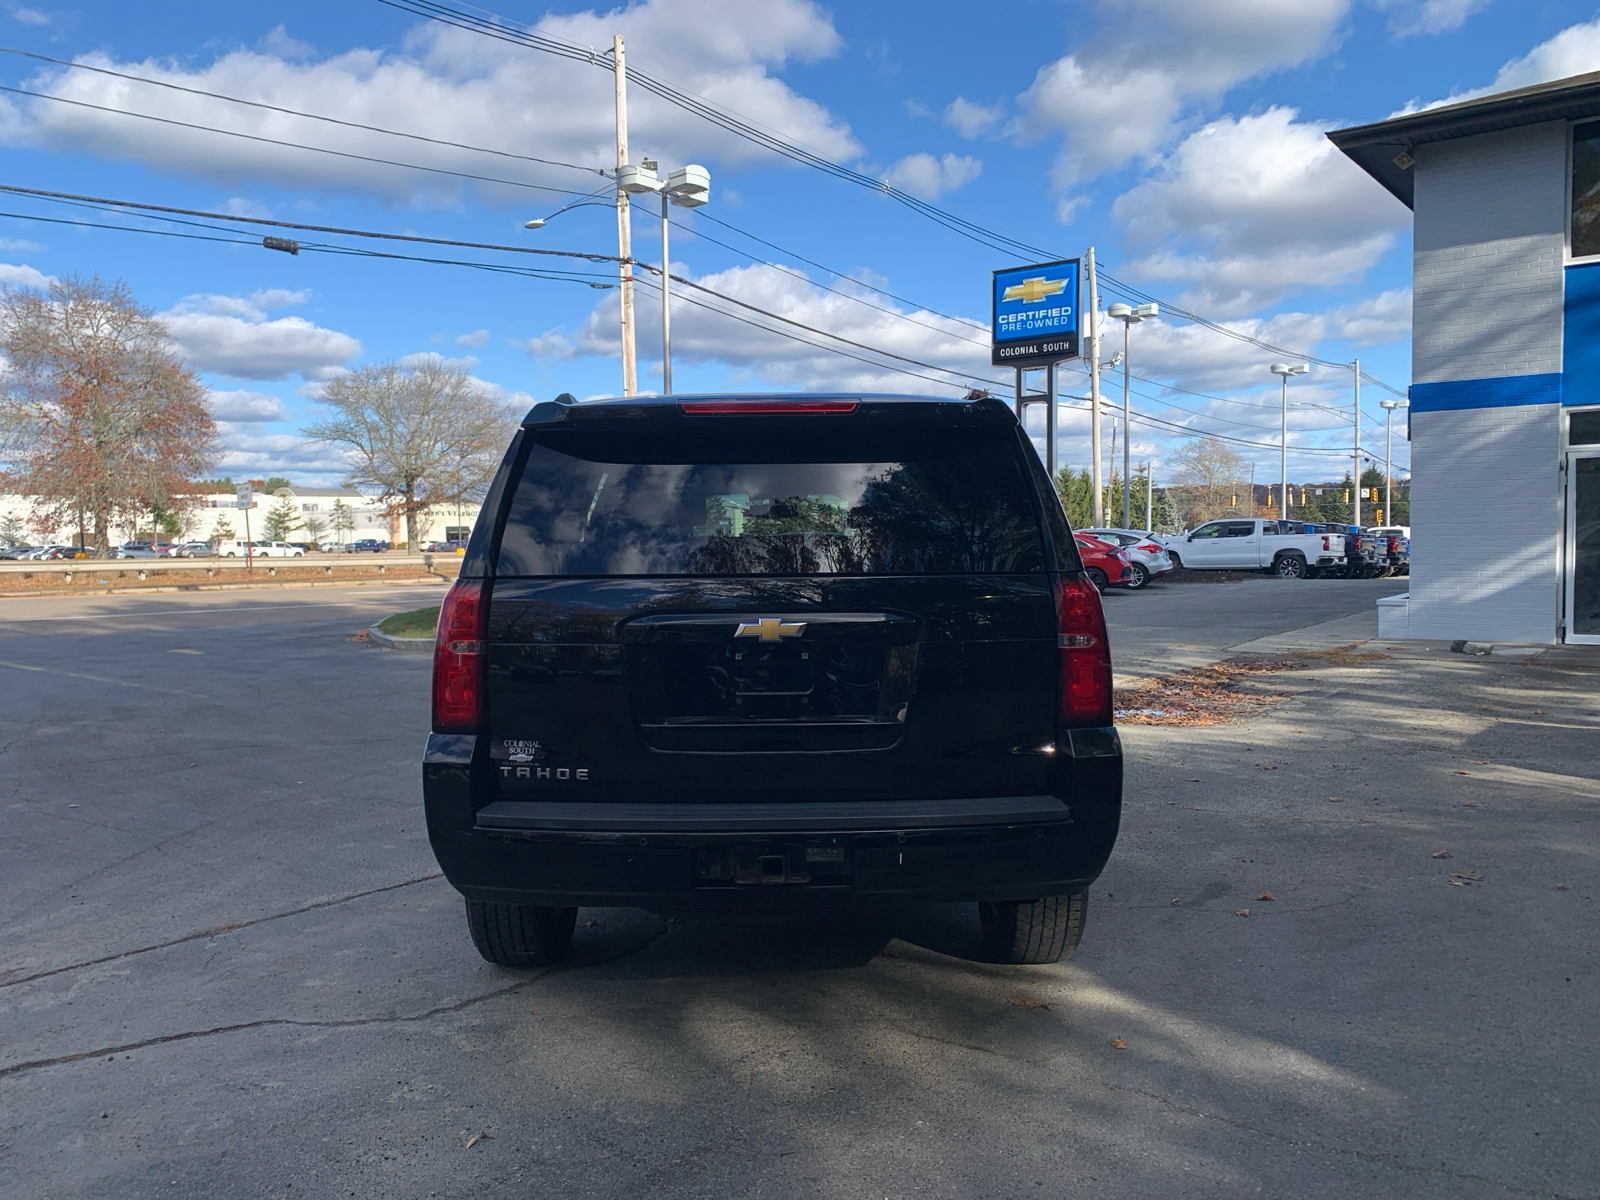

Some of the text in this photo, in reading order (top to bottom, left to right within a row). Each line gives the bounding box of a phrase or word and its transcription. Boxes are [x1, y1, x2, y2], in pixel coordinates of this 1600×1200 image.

[998, 306, 1072, 324] CERTIFIED
[1001, 316, 1068, 332] PRE-OWNED
[1000, 341, 1069, 357] COLONIAL SOUTH
[504, 739, 542, 748] COLONIAL
[499, 766, 589, 780] TAHOE
